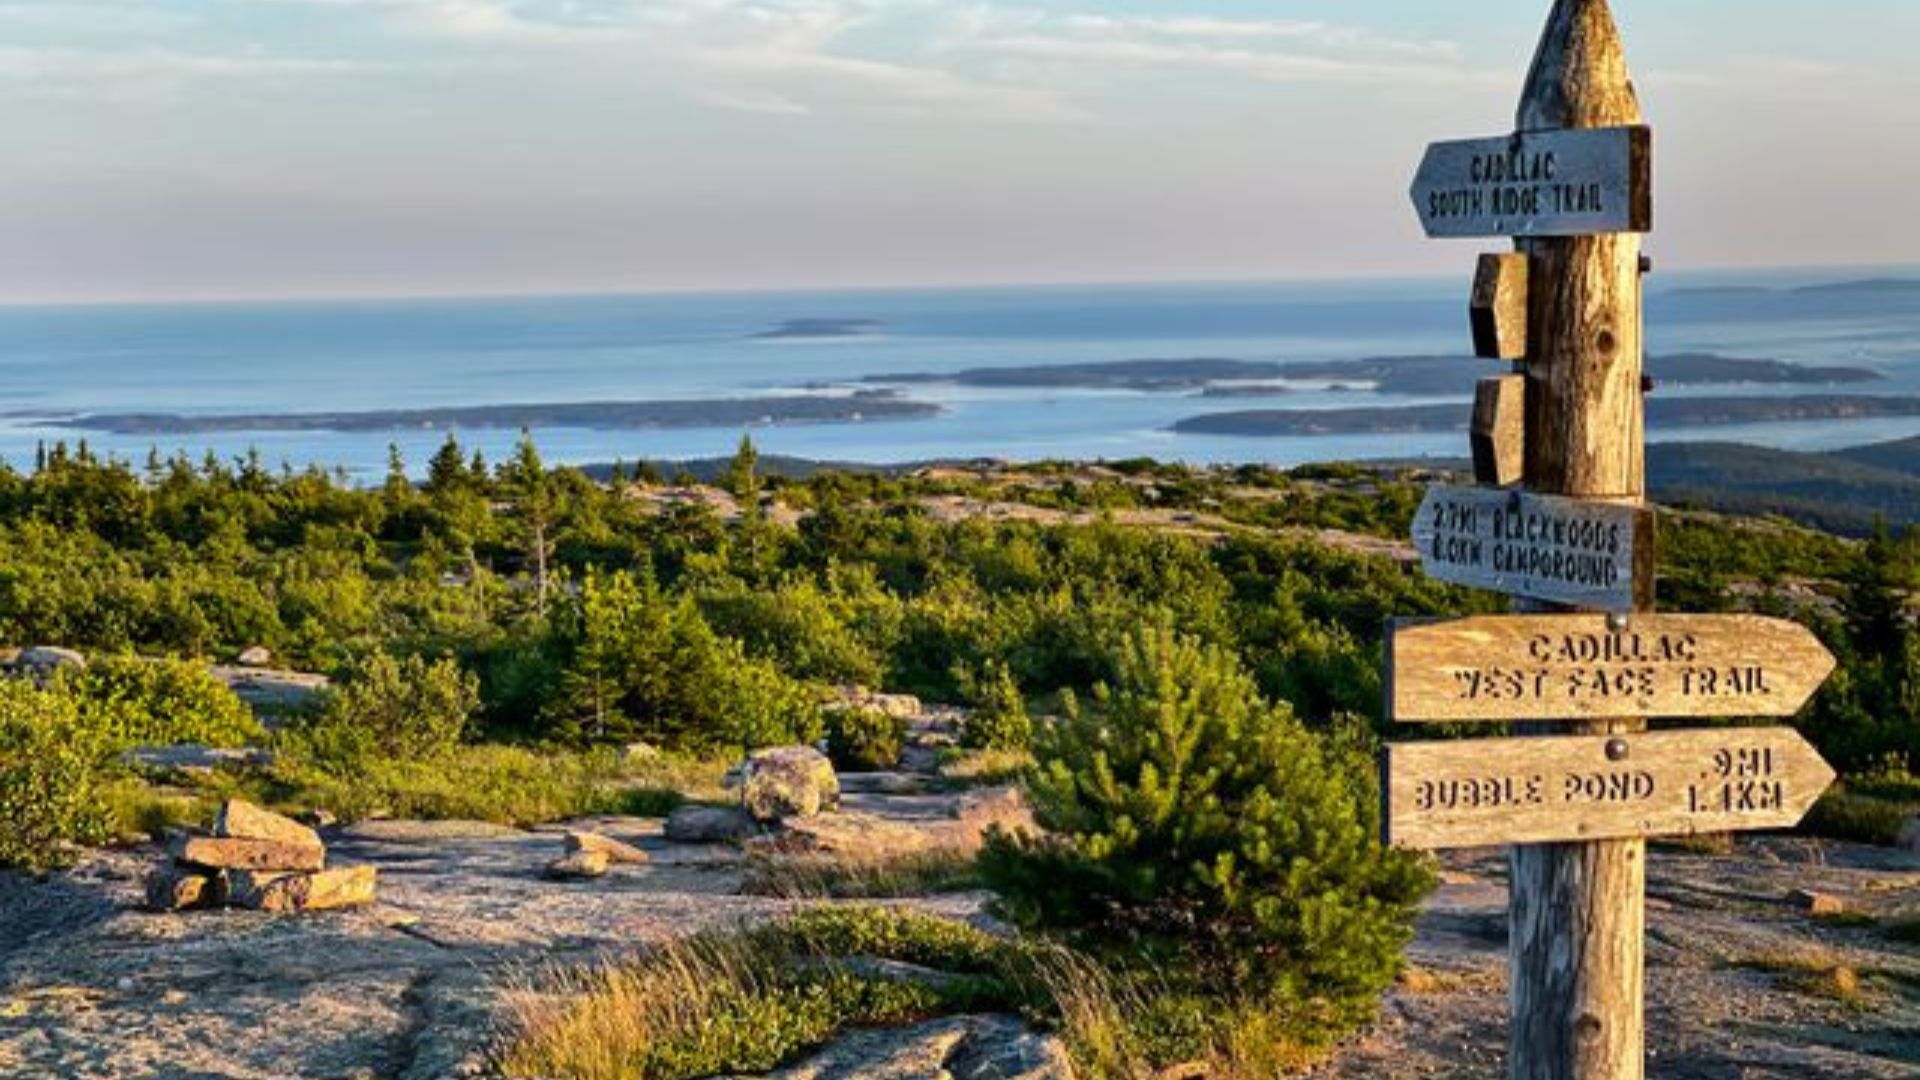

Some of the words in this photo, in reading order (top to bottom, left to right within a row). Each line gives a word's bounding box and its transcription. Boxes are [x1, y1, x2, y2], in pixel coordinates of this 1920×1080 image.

[1471, 152, 1556, 182] CADILLAC
[1429, 189, 1483, 218] SOUTH
[1492, 186, 1540, 215] RIDGE
[1554, 184, 1603, 213] TRAIL
[1493, 508, 1619, 554] BLACKWOODS
[1493, 544, 1619, 588] CAMPGROUND
[1529, 634, 1697, 663] CADILLAC
[1455, 668, 1548, 700] WEST
[1568, 668, 1656, 696] FACE
[1682, 666, 1771, 695] TRAIL
[1415, 776, 1543, 809] BUBBLE
[1564, 772, 1656, 802] POND
